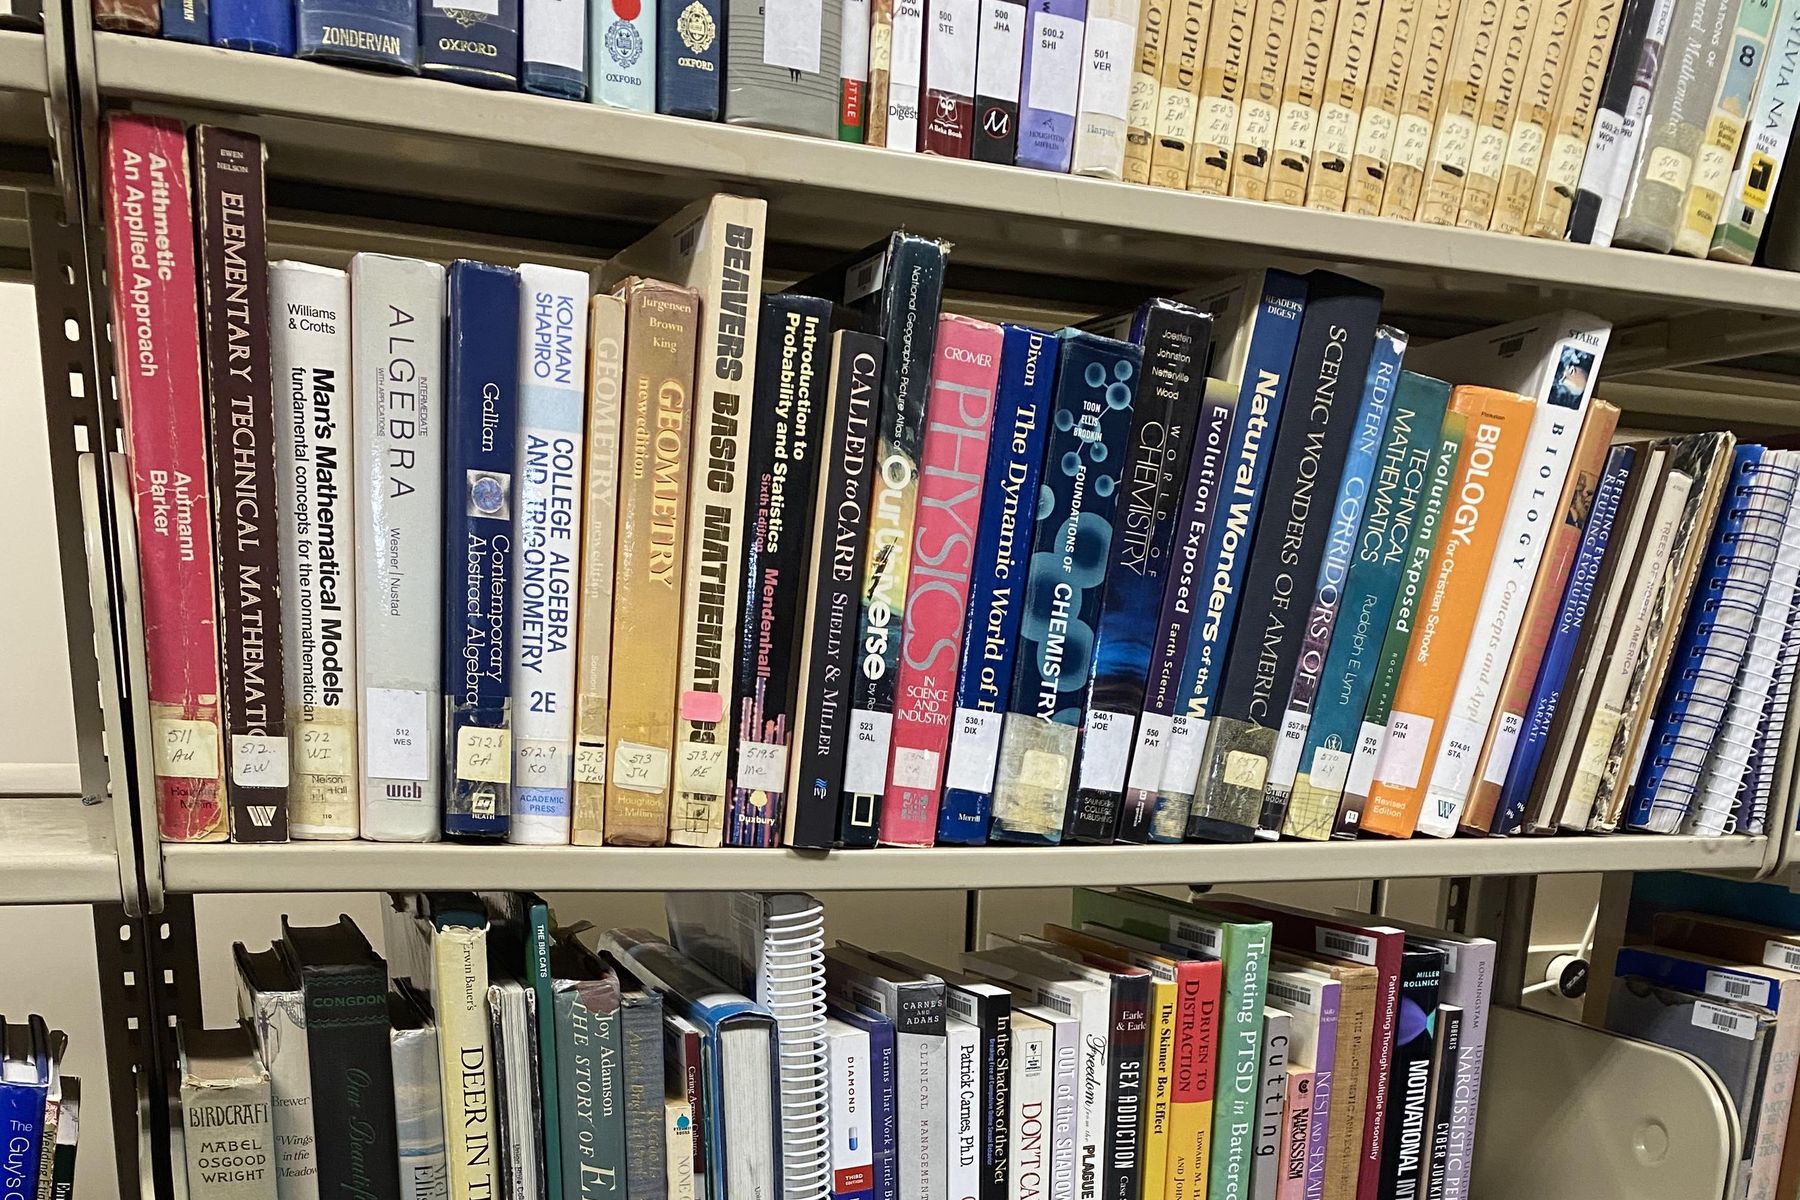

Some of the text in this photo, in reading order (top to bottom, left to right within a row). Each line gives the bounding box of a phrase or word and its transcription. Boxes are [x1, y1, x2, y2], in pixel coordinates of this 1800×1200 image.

[322, 26, 400, 55] ZONDERVAN
[439, 38, 498, 57] OXFORD
[678, 57, 714, 72] OXFORD
[1042, 27, 1064, 39] 500.2
[1092, 61, 1111, 72] VER
[606, 73, 642, 87] OXFORD
[149, 152, 175, 282] Arithmetic
[123, 148, 158, 378] An Applied Approach
[288, 303, 336, 320] Williams
[534, 292, 552, 379] SHAPIRO
[642, 296, 692, 314] Jurgensen
[1568, 329, 1599, 346] STARR
[221, 191, 261, 553] ELEMENTARY TECHNICAL
[554, 296, 574, 384] KOLMAN
[707, 223, 753, 495] BEAVERS BASIC
[944, 347, 992, 368] CROMER
[388, 304, 416, 499] ALGEBRA
[481, 382, 499, 452] Gallian
[592, 336, 619, 505] GEOMETRY
[793, 316, 819, 461] Introduction to
[1156, 388, 1178, 401] Wood
[768, 311, 801, 553] Probability and Statistics
[995, 333, 1042, 580] Dixon The Dynamic
[648, 378, 686, 591] GEOMETRY
[832, 352, 876, 582] CALLED to CARE
[1120, 421, 1165, 576] CHEMISTRY
[1360, 409, 1416, 563] MATHEMATICS
[1451, 424, 1501, 546] BIOLOGY
[312, 368, 342, 707] Man's Mathematical Models
[902, 379, 992, 673] PHYSICS
[1174, 406, 1228, 615] Evolution Exposed
[1202, 369, 1280, 643] Natural Wonders
[1246, 324, 1348, 736] SCENIC WONDERS OF AMERICA
[489, 534, 511, 683] Contemporary
[529, 438, 574, 713] COLLEGE ALGEBRA 2E
[462, 534, 486, 707] Abstract Algebra
[757, 569, 779, 678] Mendenhall
[827, 592, 849, 660] SHELLY
[860, 722, 874, 731] 523
[897, 709, 949, 726] INDUSTRY
[907, 686, 949, 702] SCIENCE
[394, 738, 412, 746] WES
[859, 732, 876, 742] GAL
[520, 794, 564, 805] ACADEMIC
[529, 804, 556, 813] PRESS
[537, 924, 545, 937] THE
[538, 939, 546, 956] BIG
[903, 1000, 944, 1010] CARNES
[1234, 937, 1265, 1093] Treating PTSD
[1404, 980, 1439, 988] ROLLNICK
[907, 1016, 939, 1025] ADAMS
[1179, 980, 1199, 1092] DISTRACTION
[461, 1045, 486, 1134] DEER
[576, 1056, 592, 1125] STORY
[847, 1057, 855, 1114] DIAMOND
[919, 1044, 928, 1110] CLINICAL
[959, 1044, 975, 1133] Patrick Carnes,
[1154, 1003, 1173, 1135] The Skinner Box Effect
[10, 1120, 33, 1131] The
[201, 1140, 262, 1153] MABEL
[579, 1131, 594, 1157] OF
[1114, 1062, 1140, 1169] SEX ADDICTION
[1398, 1059, 1430, 1177] MOTIVATIONAL
[3, 1137, 29, 1188] Guy's
[198, 1154, 266, 1168] OSGOOD
[201, 1169, 264, 1183] WRIGHT
[465, 1138, 489, 1167] IN
